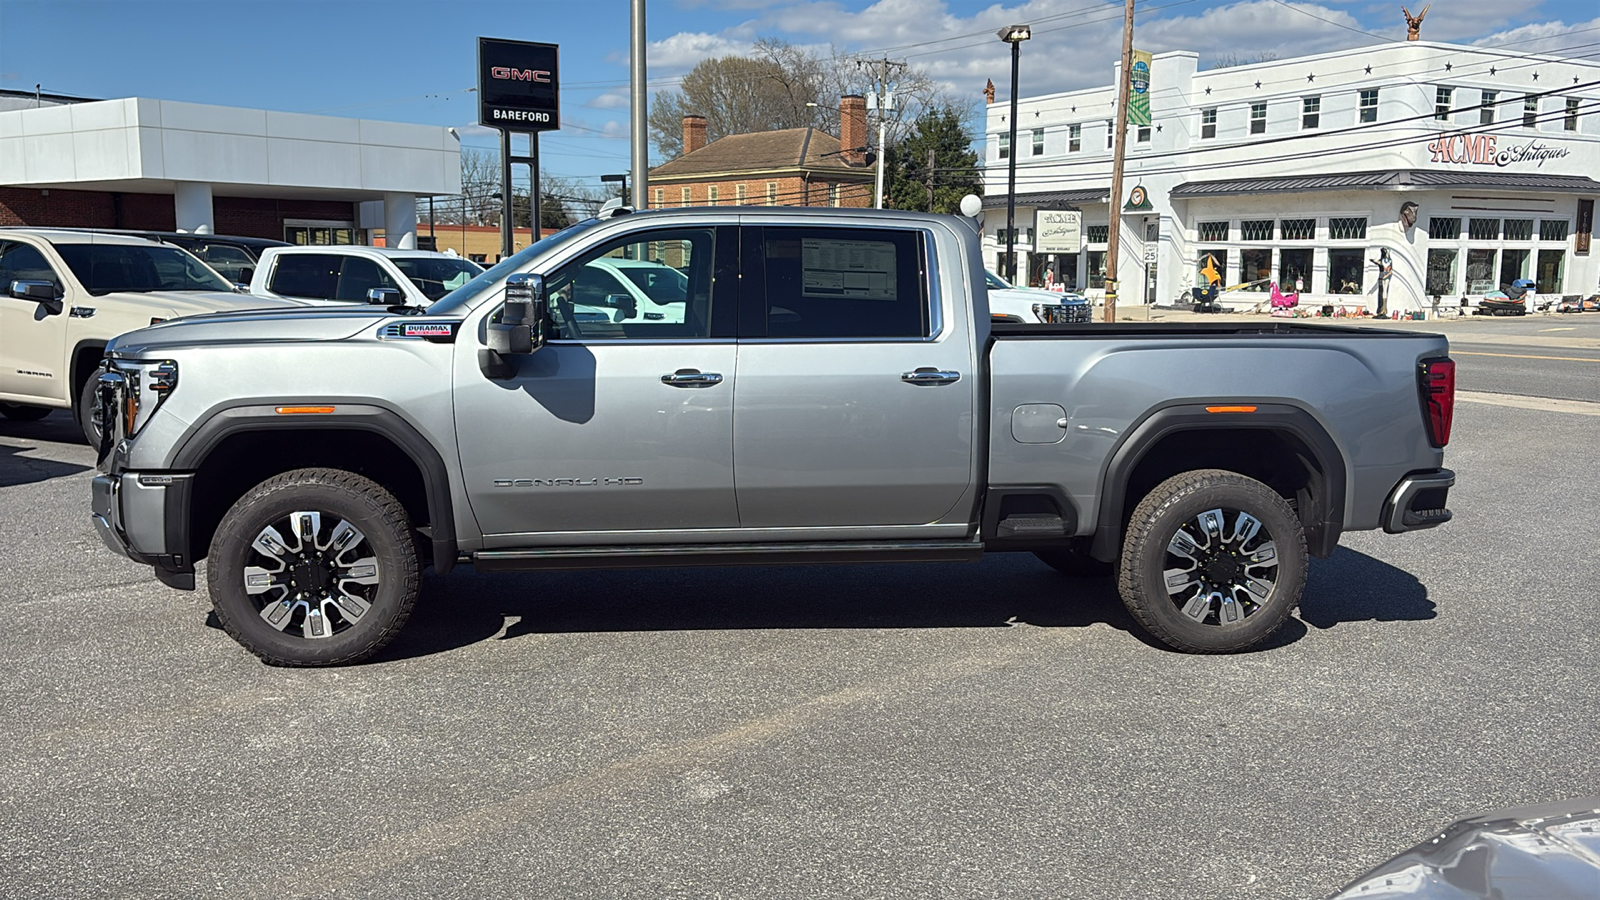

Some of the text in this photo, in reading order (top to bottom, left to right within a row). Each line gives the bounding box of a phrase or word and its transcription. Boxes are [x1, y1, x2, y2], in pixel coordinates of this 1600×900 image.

[491, 66, 551, 83] GMC
[493, 109, 550, 122] BAREFORD
[1428, 133, 1498, 165] ACME
[1144, 252, 1156, 260] 25
[494, 476, 643, 487] DENALI HD
